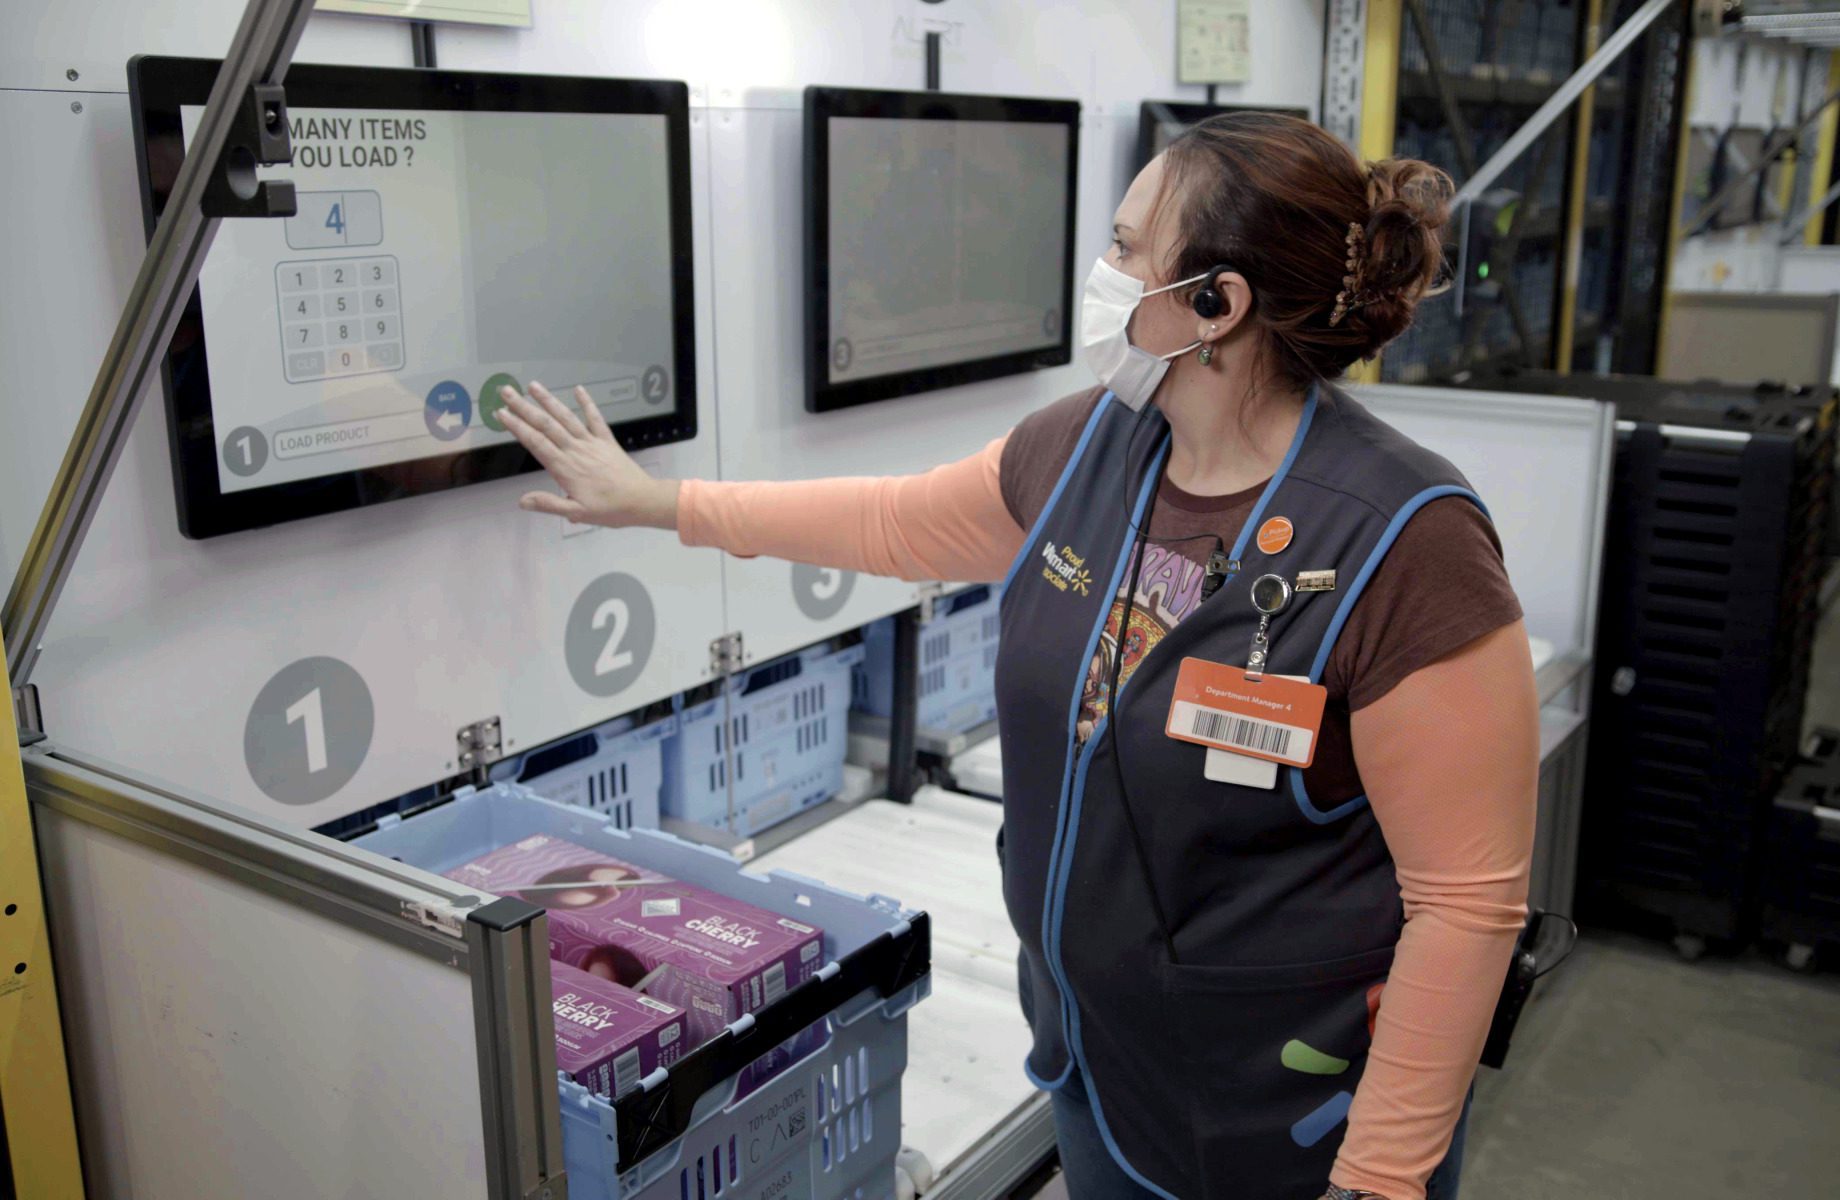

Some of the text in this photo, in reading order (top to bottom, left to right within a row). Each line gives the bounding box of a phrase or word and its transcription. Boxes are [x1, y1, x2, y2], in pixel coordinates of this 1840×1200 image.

[287, 118, 427, 140] MANY ITEMS
[289, 146, 414, 168] YOU LOAD ?
[325, 203, 344, 235] 4
[295, 266, 382, 287] 1 2 3
[297, 294, 384, 315] 4 5 6
[299, 321, 386, 343] 7 8 9
[341, 352, 351, 367] 0
[648, 372, 661, 398] 2
[236, 435, 253, 467] 1
[280, 425, 370, 452] LOAD PRODUCT
[592, 599, 633, 676] 2
[1205, 686, 1292, 711] Department Manager 4
[285, 686, 328, 774] 1
[685, 919, 760, 949] CHERRY
[704, 915, 762, 939] BLACK
[553, 1001, 615, 1030] HERRY
[557, 993, 619, 1020] BLACK
